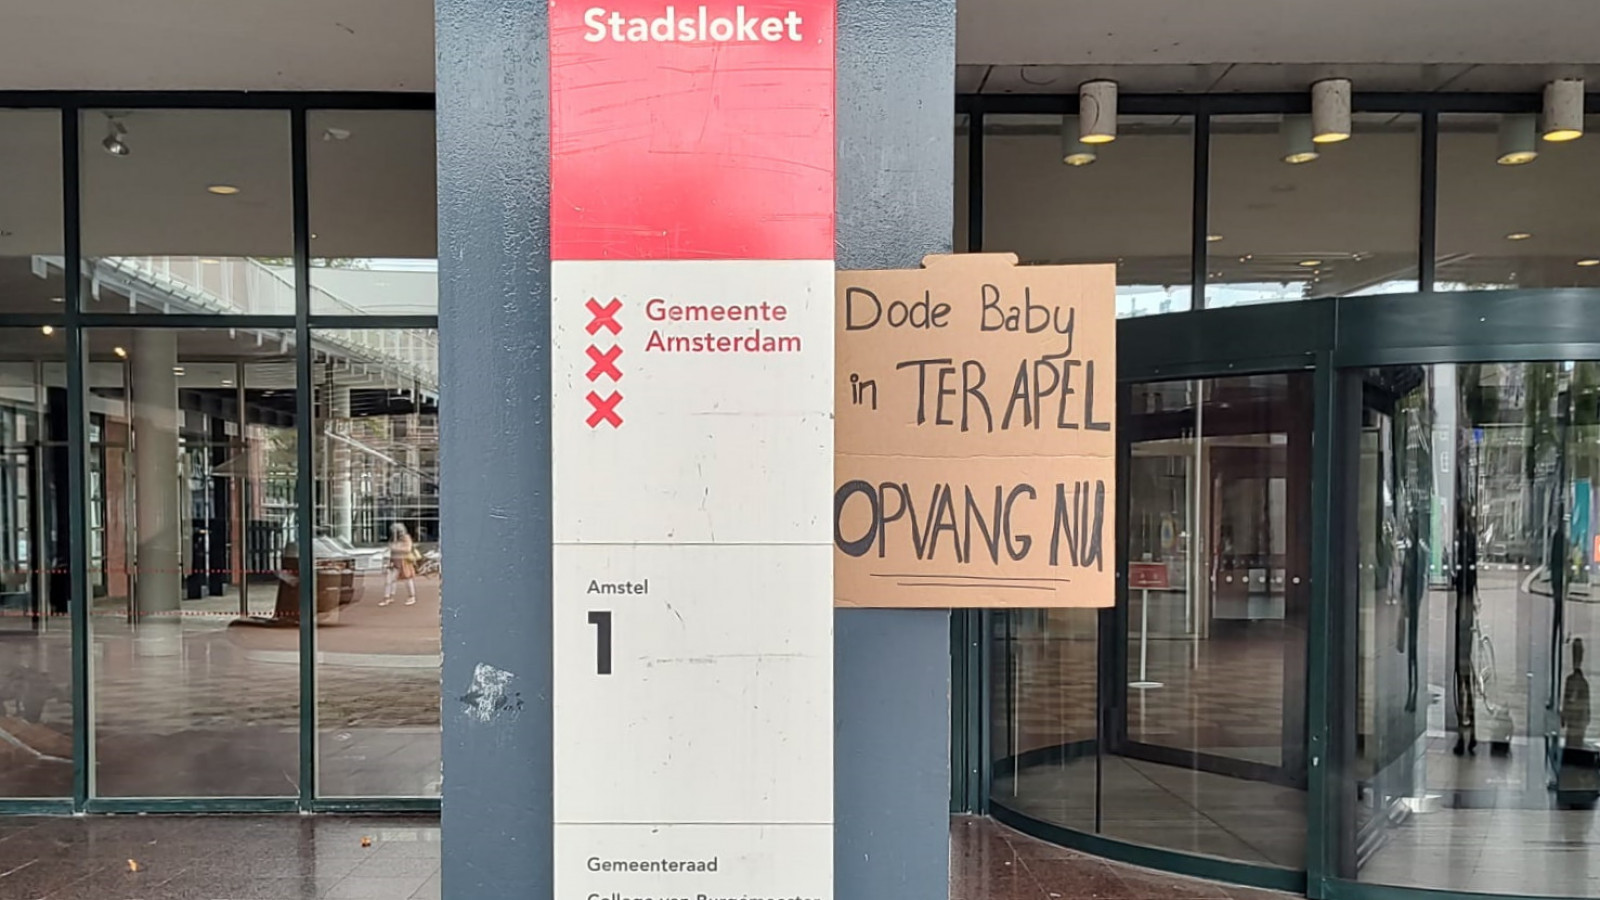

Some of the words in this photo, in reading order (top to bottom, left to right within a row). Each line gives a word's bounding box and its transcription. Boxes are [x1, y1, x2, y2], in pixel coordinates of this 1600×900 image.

[583, 5, 802, 43] Stadsloket
[645, 298, 787, 321] Gemeente
[846, 286, 951, 331] Dode
[980, 283, 1076, 361] Baby
[645, 329, 801, 353] Amsterdam
[850, 373, 877, 411] in
[896, 358, 993, 433] TER
[1001, 358, 1111, 432] APEL
[834, 479, 1037, 565] OPVANG
[1049, 480, 1105, 572] NU
[587, 578, 649, 595] Amstel
[587, 611, 612, 675] 1
[586, 856, 718, 872] Gemeenteraad
